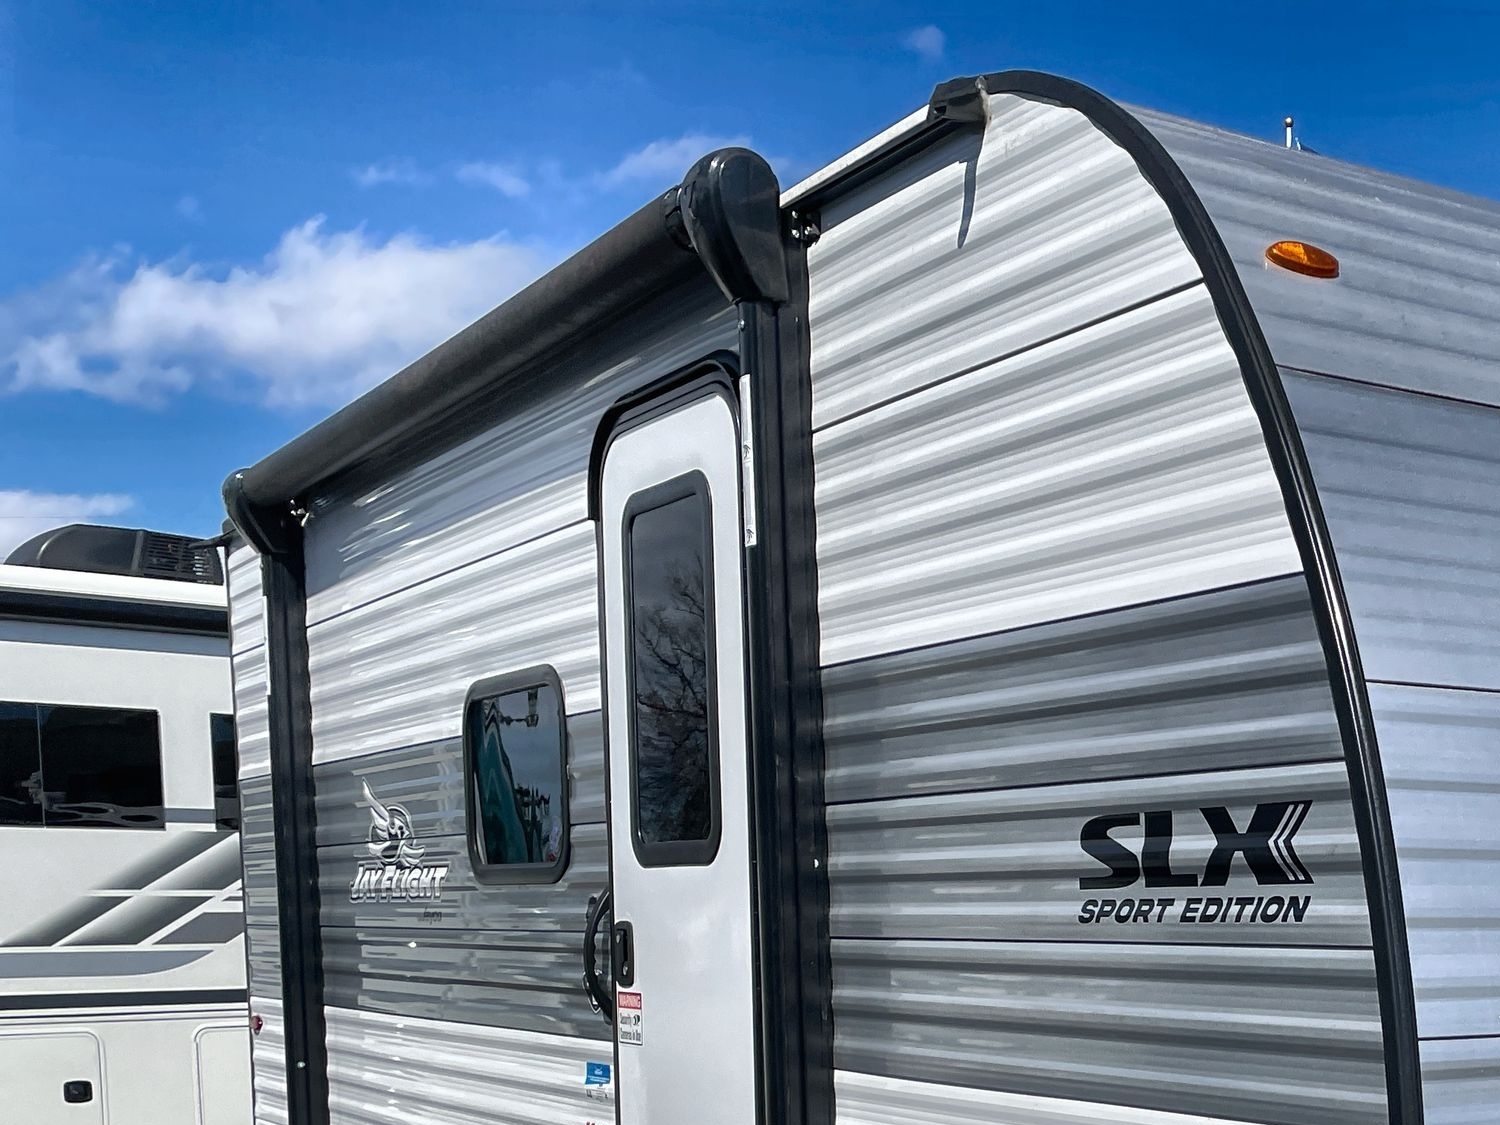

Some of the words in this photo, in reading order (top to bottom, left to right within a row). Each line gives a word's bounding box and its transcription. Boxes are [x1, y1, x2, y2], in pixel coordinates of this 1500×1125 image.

[1079, 800, 1314, 890] SLX
[380, 863, 449, 899] FLIGHT
[1078, 898, 1176, 925] SPORT
[1179, 896, 1312, 924] EDITION
